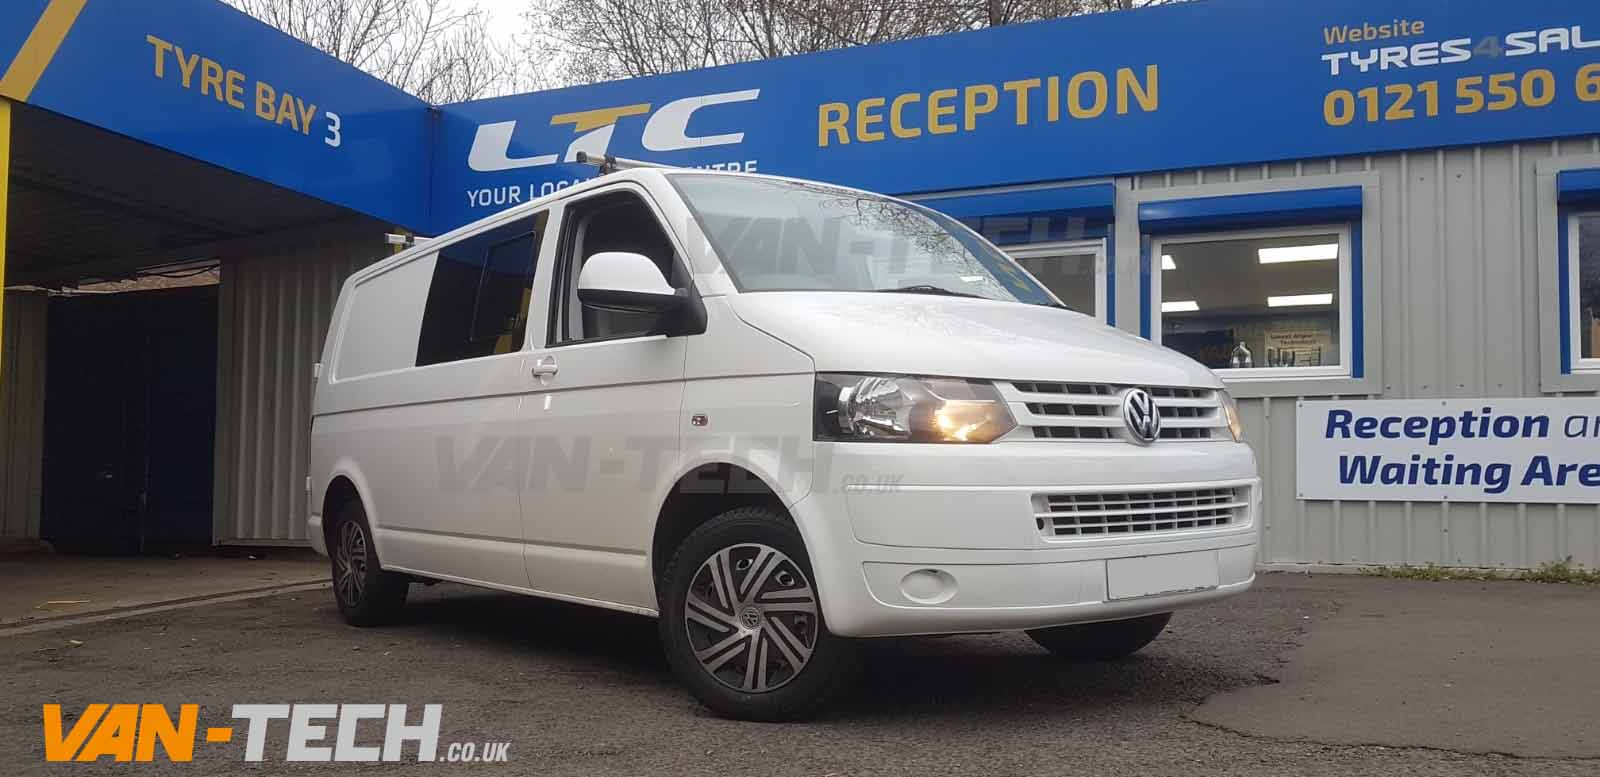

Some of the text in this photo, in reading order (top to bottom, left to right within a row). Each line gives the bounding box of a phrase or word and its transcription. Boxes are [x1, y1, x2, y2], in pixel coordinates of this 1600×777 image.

[1323, 18, 1425, 46] Website
[146, 34, 342, 148] TYRE BAY 3
[818, 63, 1159, 148] RECEPTION
[1322, 62, 1600, 127] 0121 550 6
[467, 88, 761, 172] LTC
[467, 185, 521, 208] YOUR
[1325, 407, 1550, 446] Reception
[1338, 454, 1600, 494] Waiting Are
